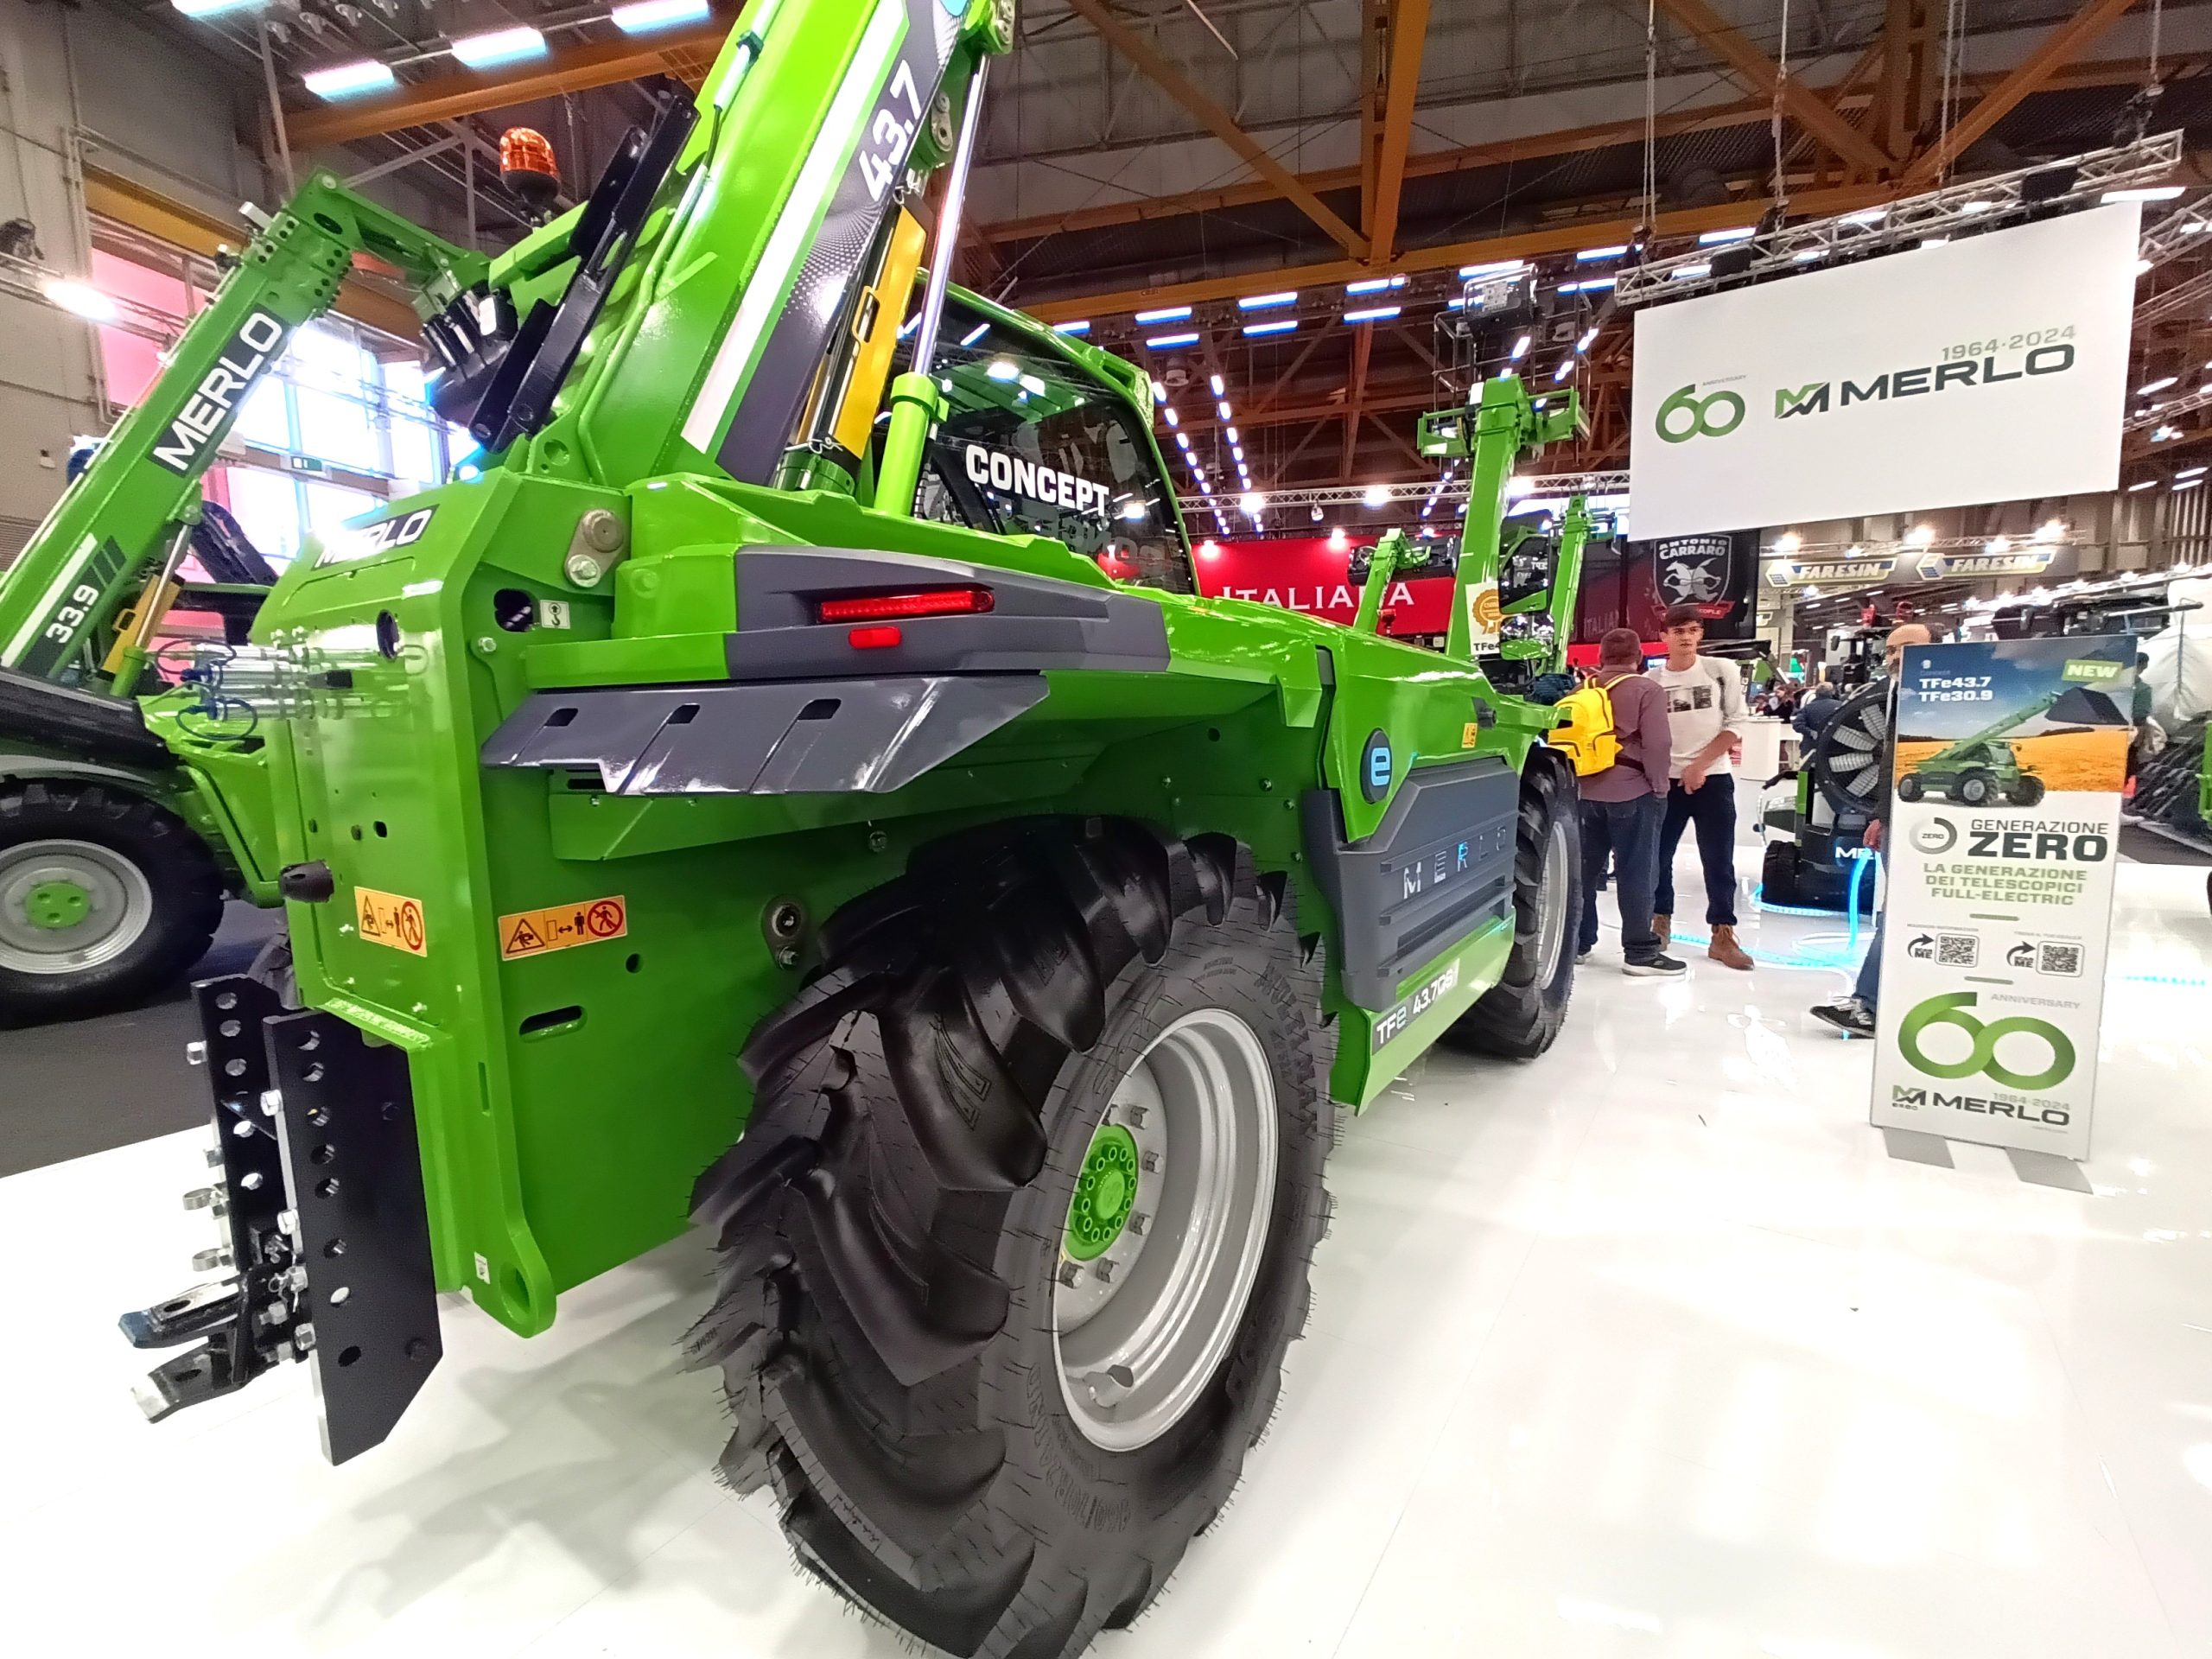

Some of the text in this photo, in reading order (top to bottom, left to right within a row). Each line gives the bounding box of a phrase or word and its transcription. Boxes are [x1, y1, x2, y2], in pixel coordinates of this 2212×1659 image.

[859, 60, 922, 201] 43.7
[1840, 343, 2075, 406] MERLO
[152, 312, 283, 471] MERLO
[1655, 383, 1746, 443] 60
[965, 444, 1110, 517] CONCEPT
[1659, 538, 1727, 550] ANTONIO
[1659, 545, 1726, 560] CARRARO
[1797, 563, 1880, 580] FARESIN
[1950, 554, 2039, 573] FARESIN
[1223, 582, 1415, 610] ITALIAA
[45, 584, 99, 644] 33.9
[1918, 677, 1992, 689] TFe43.7
[2066, 664, 2119, 678] NEW
[1918, 690, 1993, 702] TFe30.9
[1370, 747, 1390, 786] e
[1971, 818, 2109, 835] GENERAZIONE
[1967, 831, 2108, 862] ZERO
[1403, 826, 1507, 899] MERLO
[1923, 862, 2088, 880] LA GENERAZIONE
[1925, 875, 2082, 893] DEI TELESCOPICI
[1931, 887, 2075, 906] FULL-ELECTRIC
[1990, 993, 2080, 1009] ANNIVERSARY
[1376, 1006, 1408, 1044] TFe
[1897, 991, 2076, 1091] 60
[1932, 1091, 2070, 1127] MERLO
